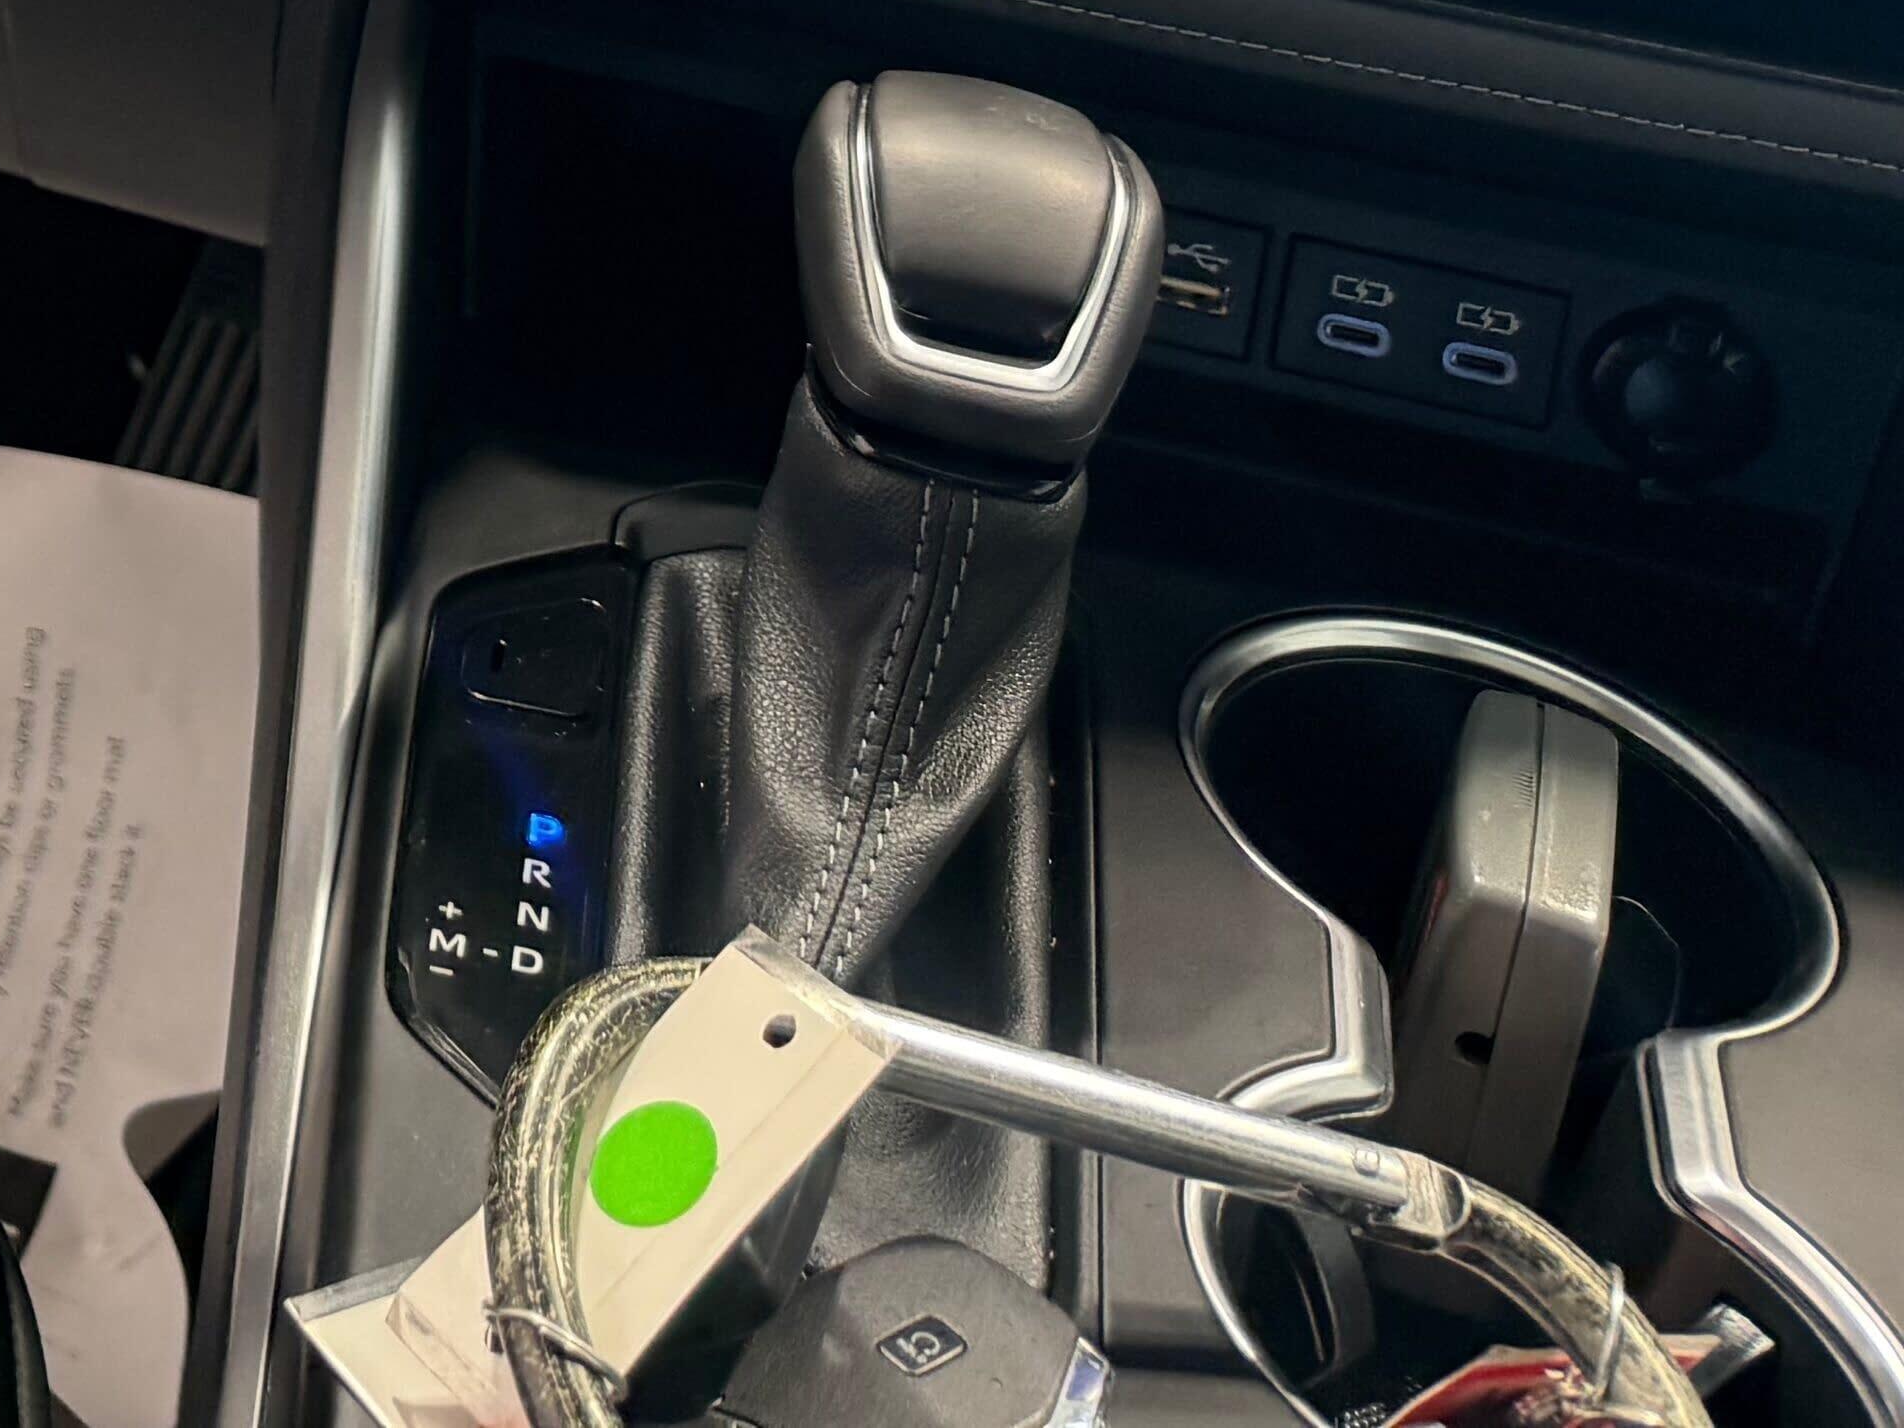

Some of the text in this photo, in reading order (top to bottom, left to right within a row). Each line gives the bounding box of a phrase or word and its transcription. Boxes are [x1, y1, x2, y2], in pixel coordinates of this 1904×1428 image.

[528, 812, 565, 846] P
[522, 858, 551, 887] R
[517, 902, 549, 931] N
[429, 928, 467, 957] M
[510, 946, 544, 973] D
